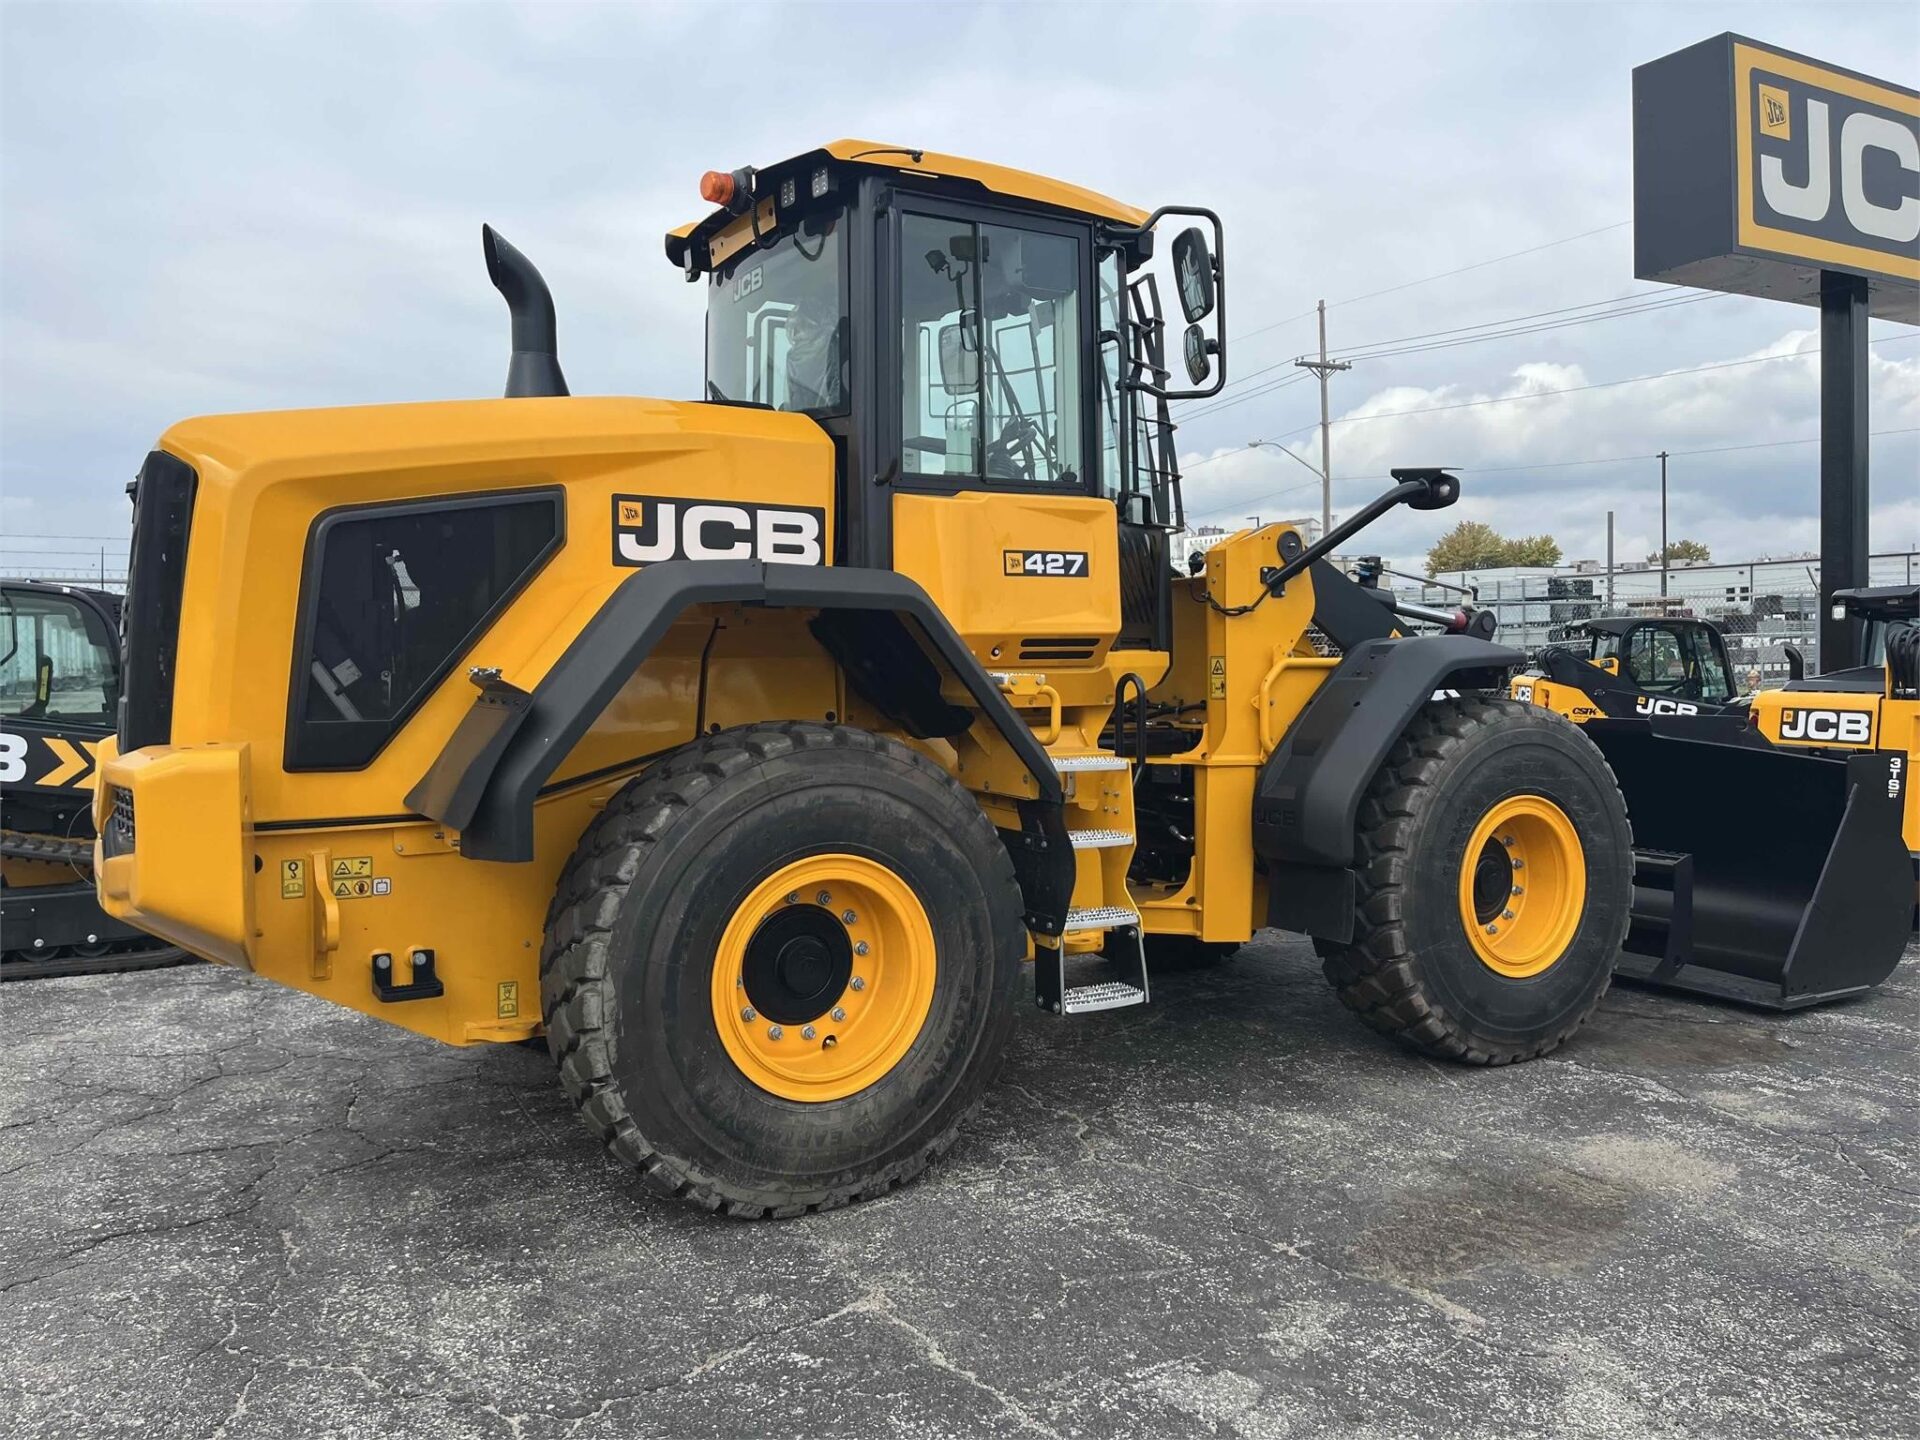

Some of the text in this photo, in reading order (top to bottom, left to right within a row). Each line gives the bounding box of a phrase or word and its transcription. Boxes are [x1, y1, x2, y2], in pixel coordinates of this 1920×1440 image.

[1767, 98, 1785, 123] JCB
[734, 266, 763, 301] JCB
[619, 503, 820, 566] JCB
[1025, 553, 1084, 574] 427
[1516, 686, 1531, 701] JCB
[1781, 710, 1870, 742] JCB
